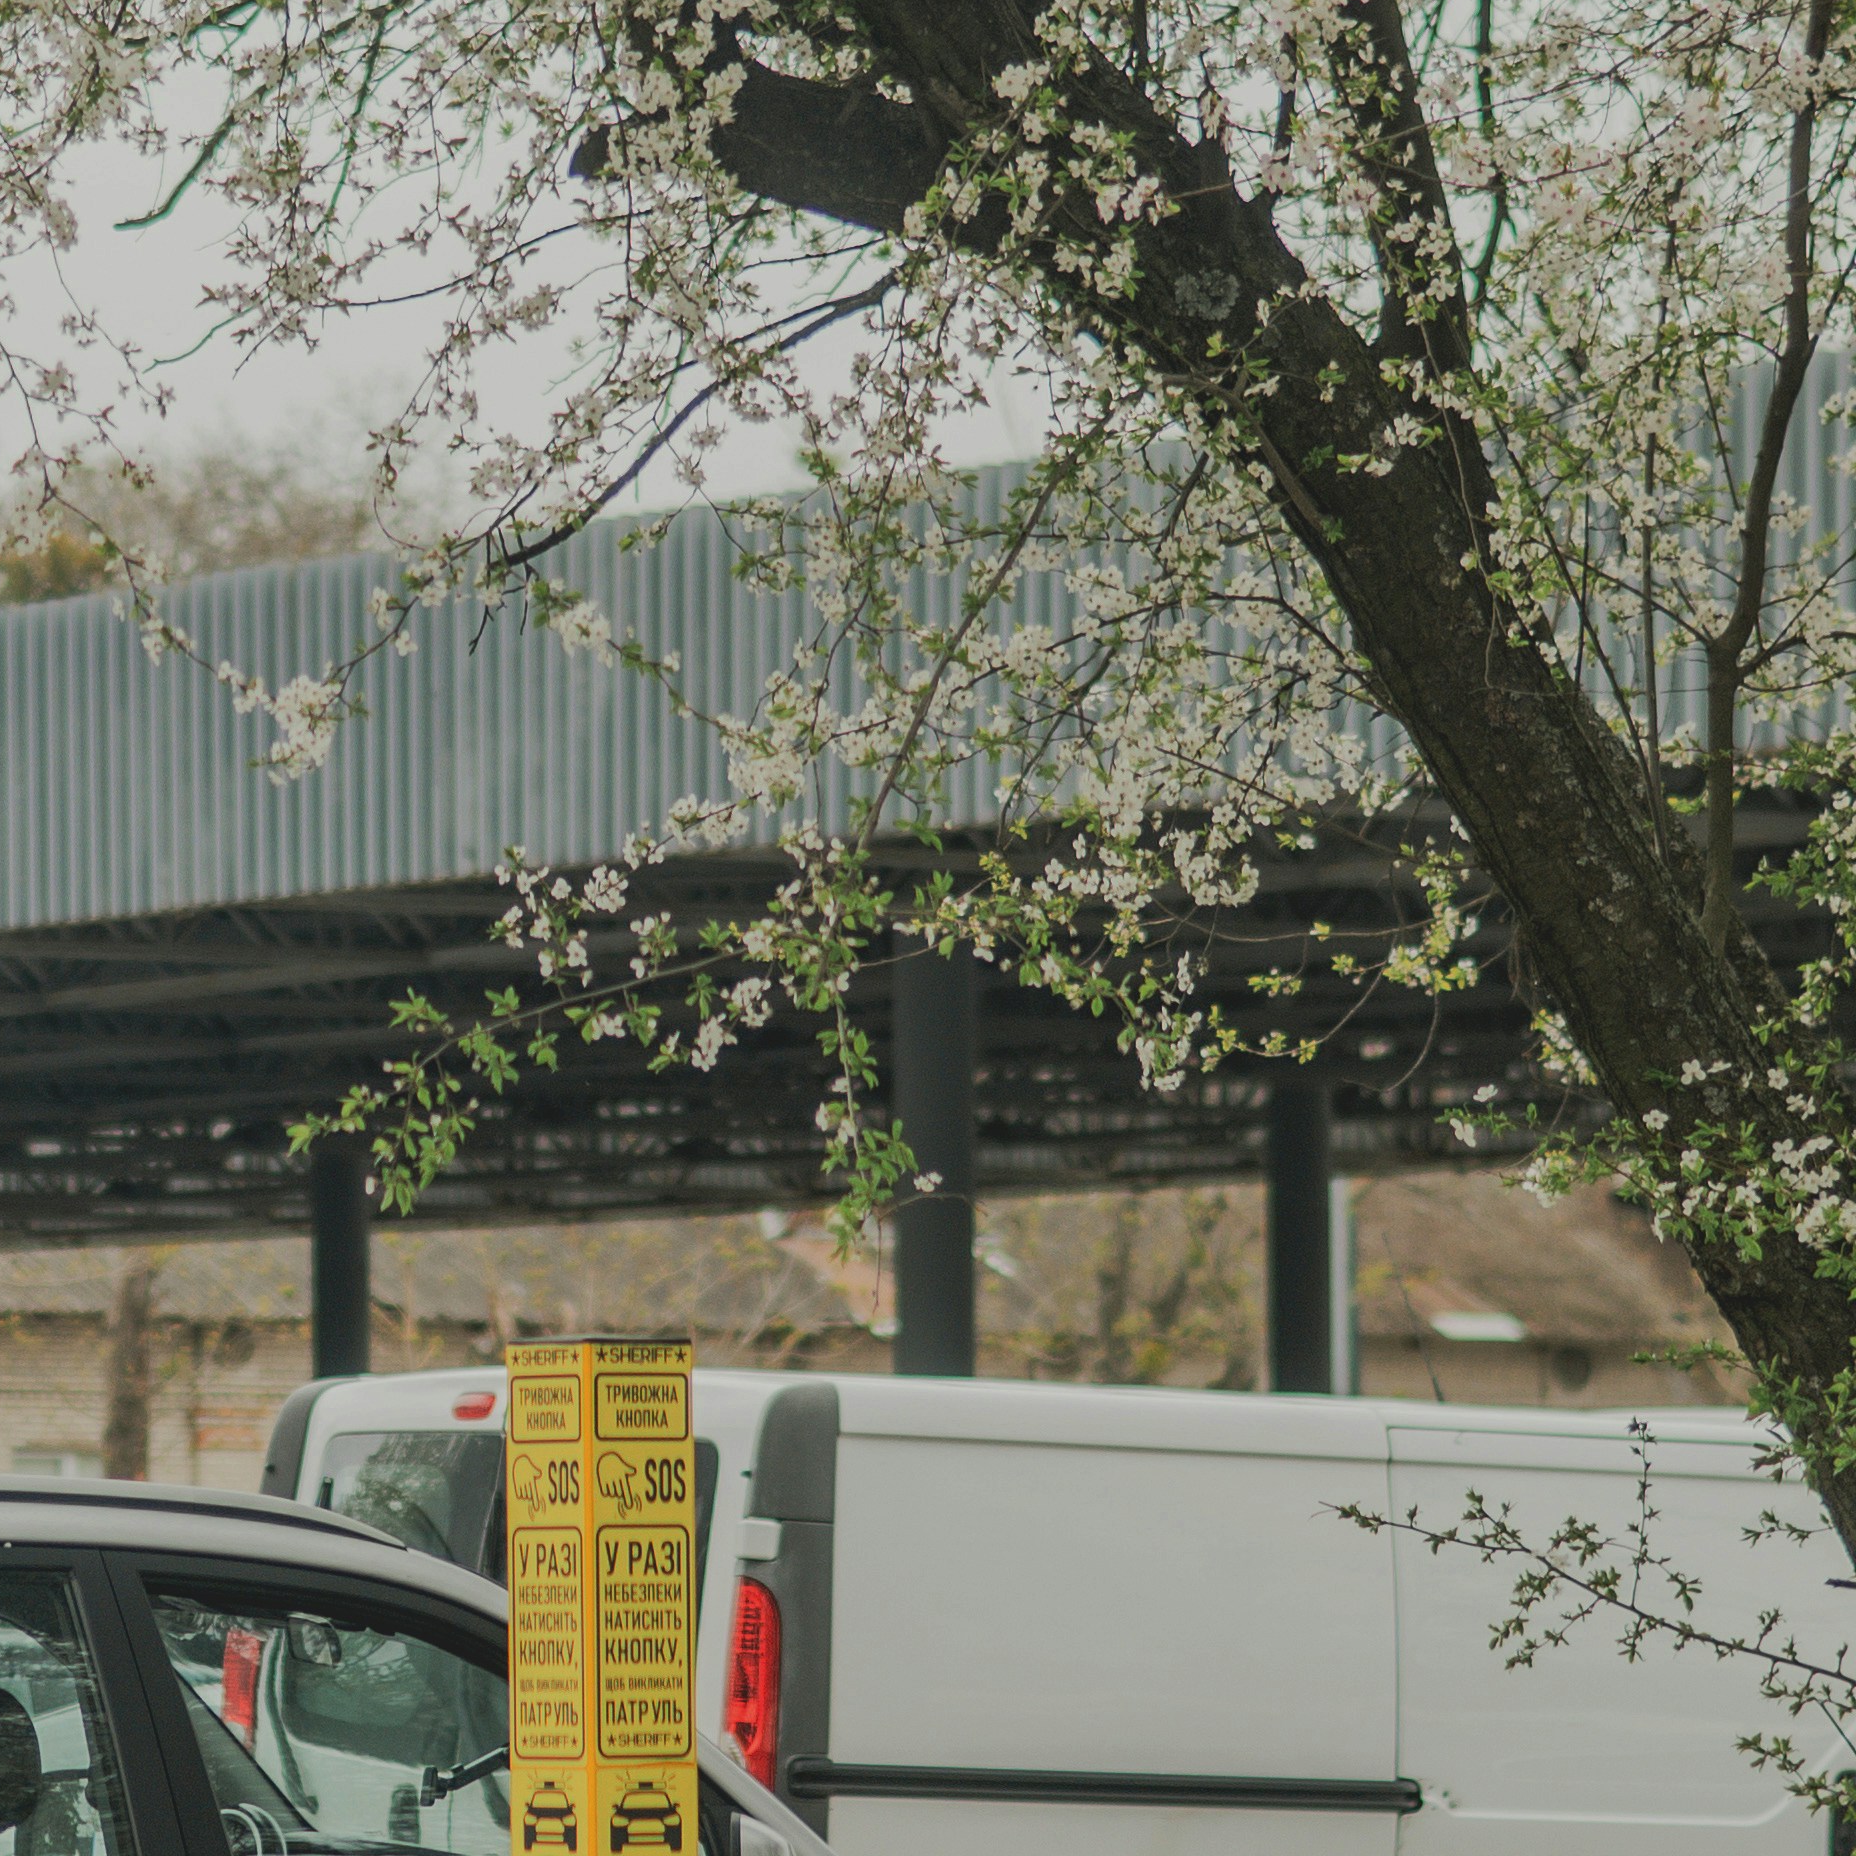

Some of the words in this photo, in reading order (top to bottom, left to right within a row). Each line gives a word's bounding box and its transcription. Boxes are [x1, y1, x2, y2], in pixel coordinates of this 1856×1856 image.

[521, 1349, 568, 1366] SHERIFF
[610, 1347, 673, 1364] SHERIFF
[519, 1387, 574, 1406] ТРИВОЖНА
[606, 1385, 678, 1404] ТРИВОЖНА
[527, 1411, 566, 1430] КНОПКА
[616, 1409, 668, 1428] КНОПКА
[548, 1460, 580, 1504] SOS
[645, 1458, 686, 1503] SOS
[519, 1543, 529, 1578] У
[537, 1542, 577, 1578] РАЗІ
[604, 1541, 619, 1576] У
[628, 1541, 681, 1576] РАЗІ
[519, 1585, 577, 1605] НЕБЕЗПЕКИ
[605, 1583, 682, 1603] НЕБЕЗПЕКИ
[519, 1611, 577, 1633] НАТИСНІТЬ
[605, 1609, 682, 1631] НАТИСНІТЬ
[519, 1639, 578, 1670] КНОПКУ,
[605, 1637, 683, 1668] КНОПКУ,
[606, 1677, 625, 1692] ЩОБ
[629, 1676, 683, 1691] ВИКЛИКАТИ
[520, 1701, 578, 1727] ПАТРУЛЬ
[606, 1699, 683, 1725] ПАТРУЛЬ
[618, 1732, 672, 1748] SHERIFF
